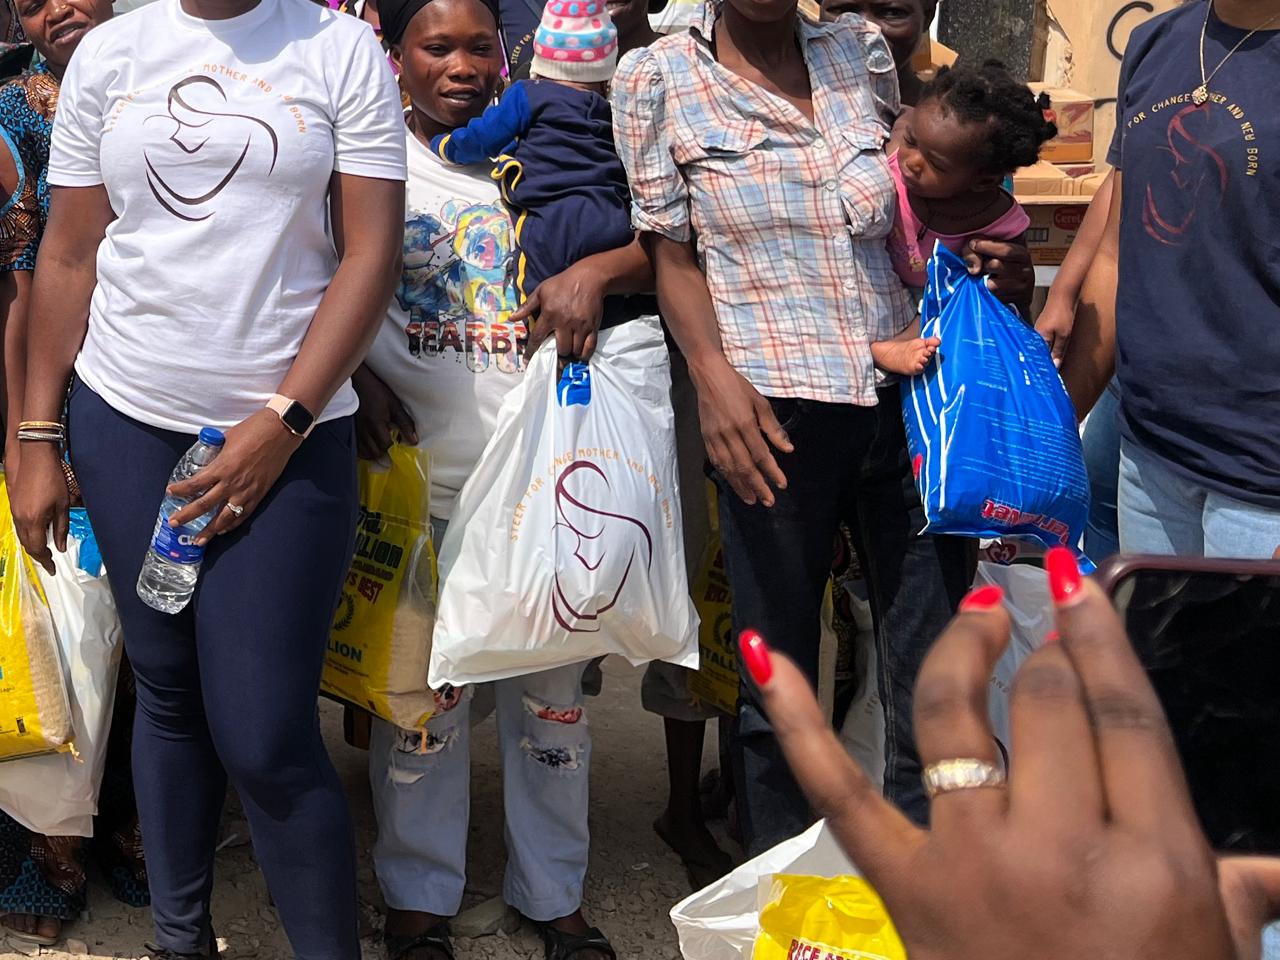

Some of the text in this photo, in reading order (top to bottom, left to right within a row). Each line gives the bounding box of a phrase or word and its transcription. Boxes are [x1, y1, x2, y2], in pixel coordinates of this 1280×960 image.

[203, 63, 247, 82] MOTHER
[290, 106, 309, 134] BORN
[1151, 93, 1191, 113] CHANGE
[1127, 111, 1147, 128] FOR
[1226, 103, 1246, 120] AND
[1241, 121, 1256, 141] NEW
[1246, 147, 1258, 176] BORN
[511, 502, 527, 541] STEER
[526, 477, 544, 498] FOR
[548, 451, 574, 476] CNGE
[578, 448, 620, 460] MOTHER
[327, 640, 362, 664] LION
